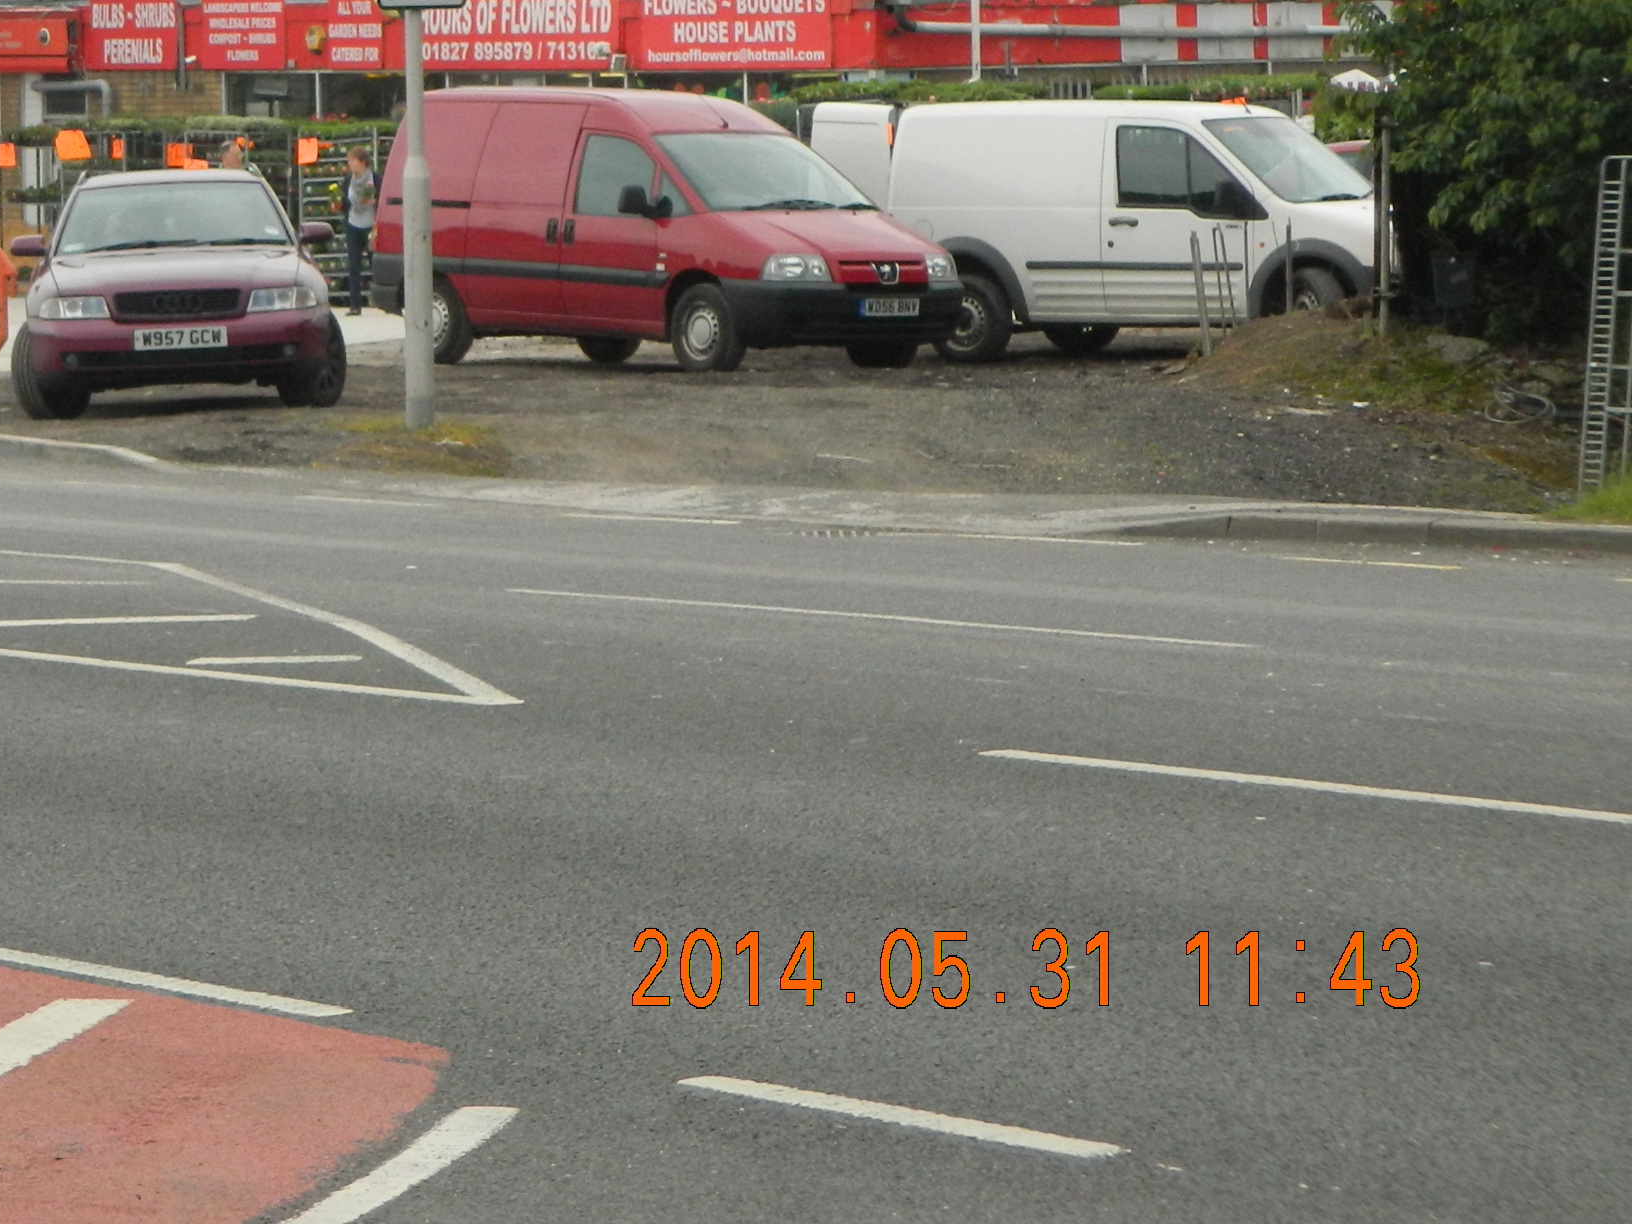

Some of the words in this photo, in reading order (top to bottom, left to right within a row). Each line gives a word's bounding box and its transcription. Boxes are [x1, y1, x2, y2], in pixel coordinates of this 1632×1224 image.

[92, 3, 125, 29] BULBS
[135, 2, 176, 29] SHRUBS
[337, 0, 351, 15] ALL
[351, 0, 372, 15] YOUR
[328, 23, 358, 38] GARDEN
[358, 23, 383, 38] NEEDS
[673, 21, 729, 44] HOUSE
[734, 20, 797, 43] PLANTS
[103, 38, 163, 64] PERENIALS
[331, 47, 363, 62] CATERED
[364, 47, 379, 62] FOR
[422, 41, 469, 61] 01827
[474, 41, 533, 61] 895879
[547, 41, 609, 61] 71316
[142, 330, 184, 347] W957
[189, 329, 222, 345] GCW
